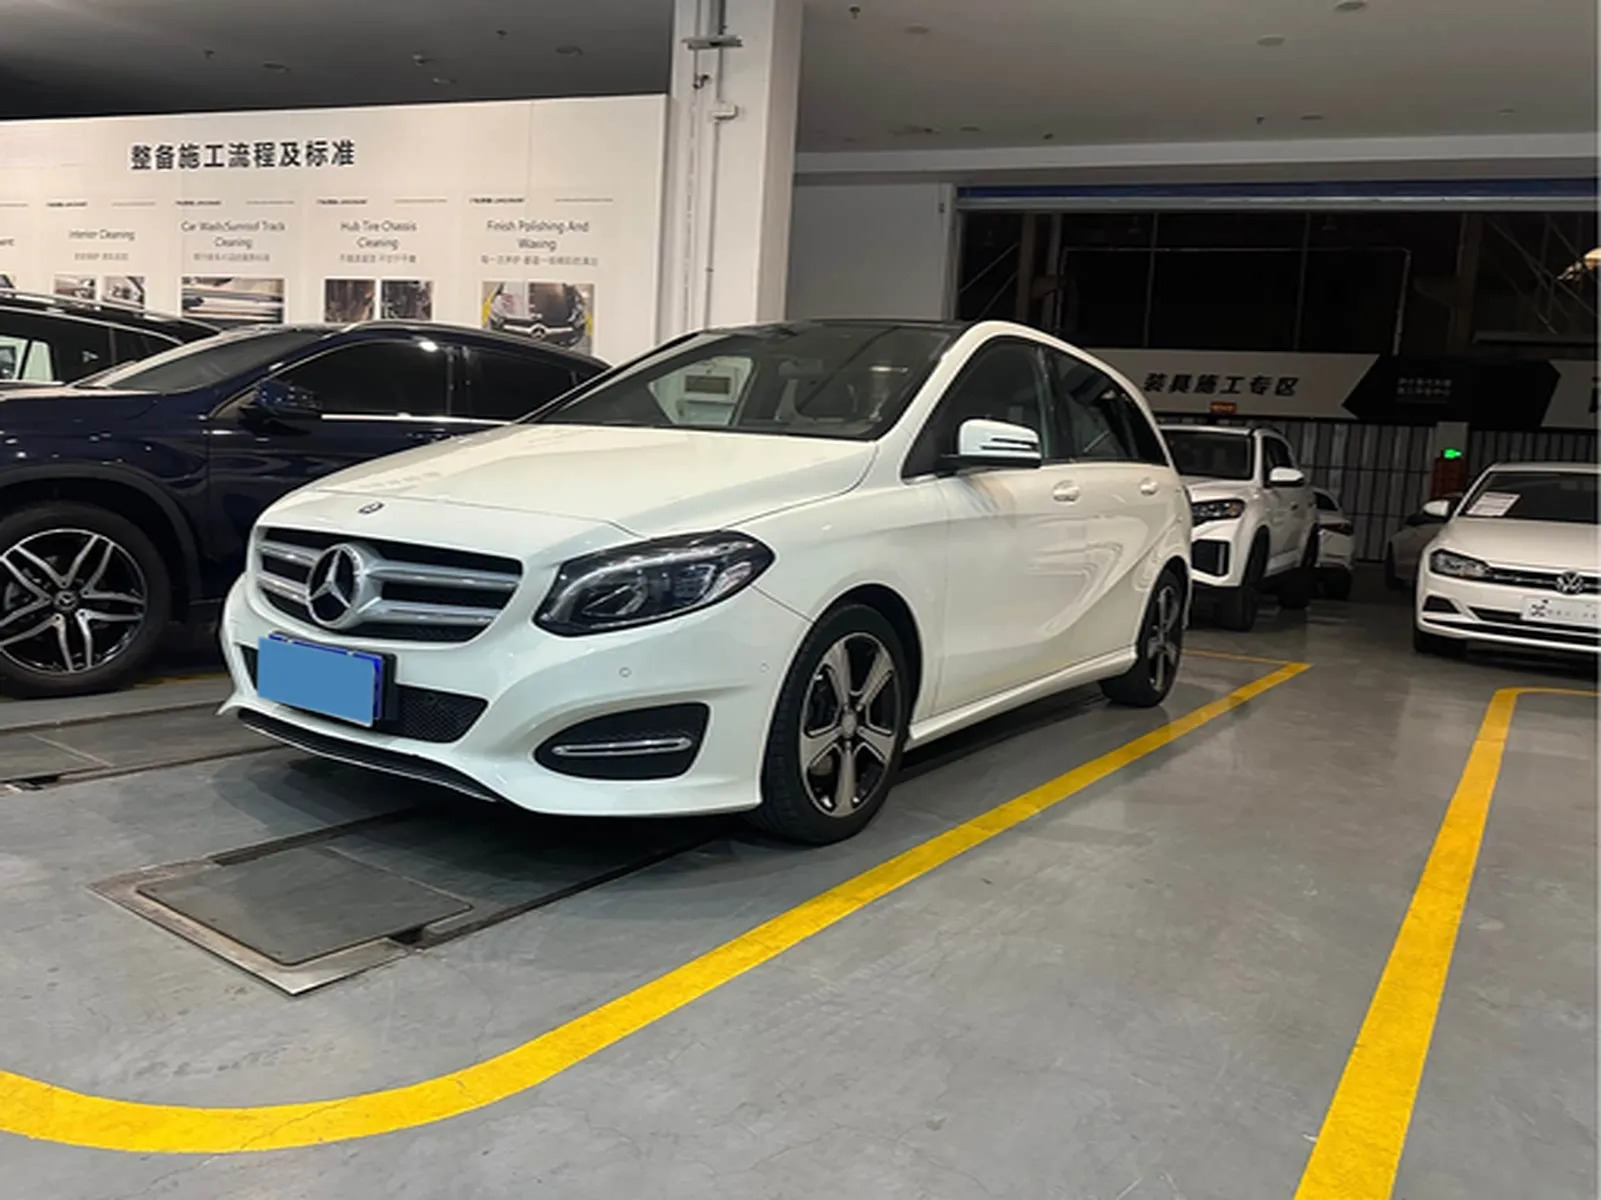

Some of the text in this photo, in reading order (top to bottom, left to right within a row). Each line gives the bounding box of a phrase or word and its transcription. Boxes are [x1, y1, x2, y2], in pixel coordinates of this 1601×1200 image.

[131, 140, 354, 170] 整备施工流程及标准
[181, 221, 196, 232] Car
[262, 221, 286, 232] Track
[341, 220, 417, 232] Hub Tire Chassis
[487, 220, 590, 235] Finish Polishing And
[69, 229, 135, 241] Interior Cleaning
[214, 236, 252, 250] Cleaning
[356, 236, 399, 251] Cleaning
[517, 238, 558, 252] Waxing
